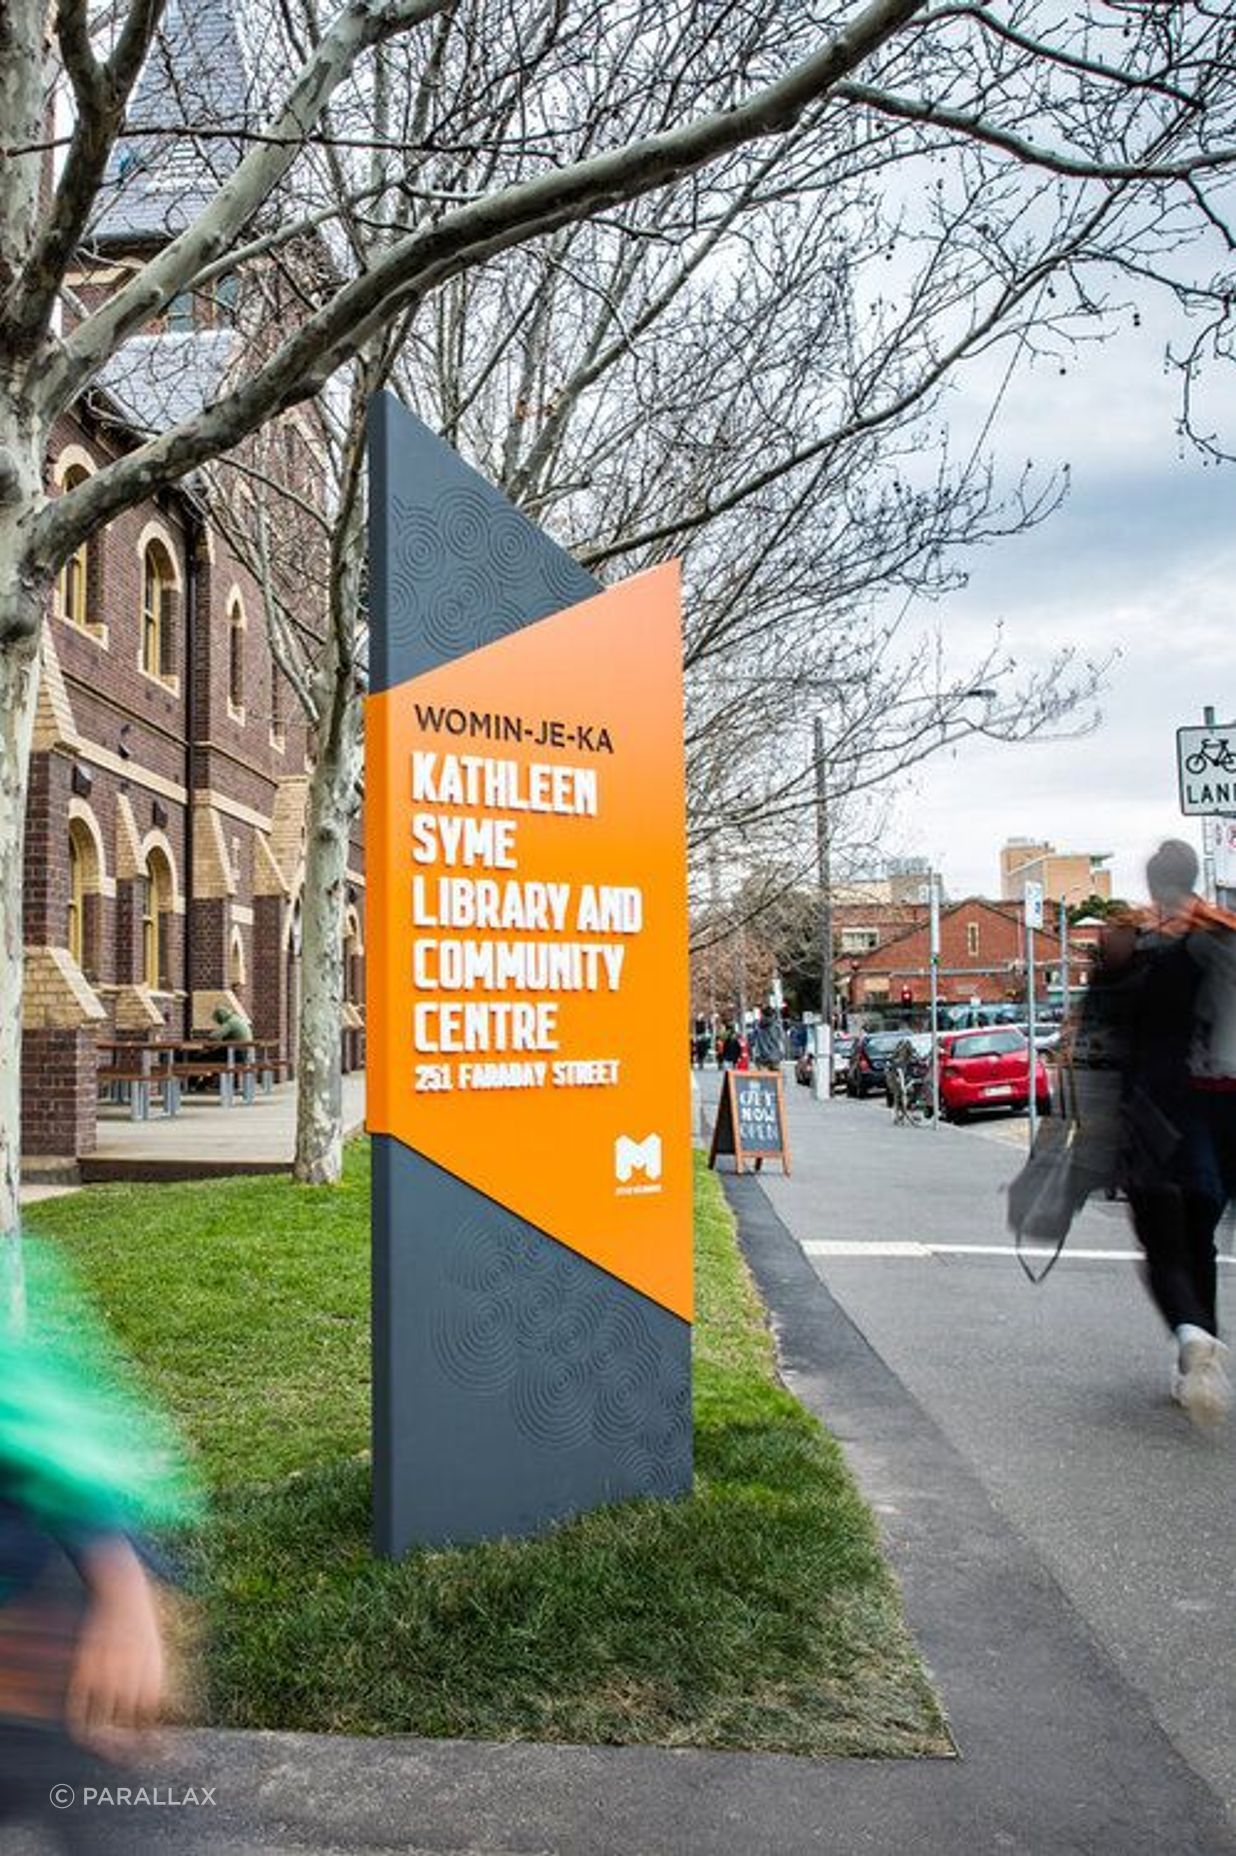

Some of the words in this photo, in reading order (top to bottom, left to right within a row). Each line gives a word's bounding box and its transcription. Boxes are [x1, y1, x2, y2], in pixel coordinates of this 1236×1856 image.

[414, 703, 615, 754] WOMIN-JE-KA
[412, 750, 598, 817] KATHLEEN
[1186, 783, 1236, 805] LAN
[412, 812, 518, 869] SYME
[412, 875, 570, 932] LIBRARY
[577, 884, 644, 934] AND
[413, 938, 625, 992] COMMUNITY
[414, 1001, 560, 1053] CENTRE
[552, 1058, 621, 1086] STREET
